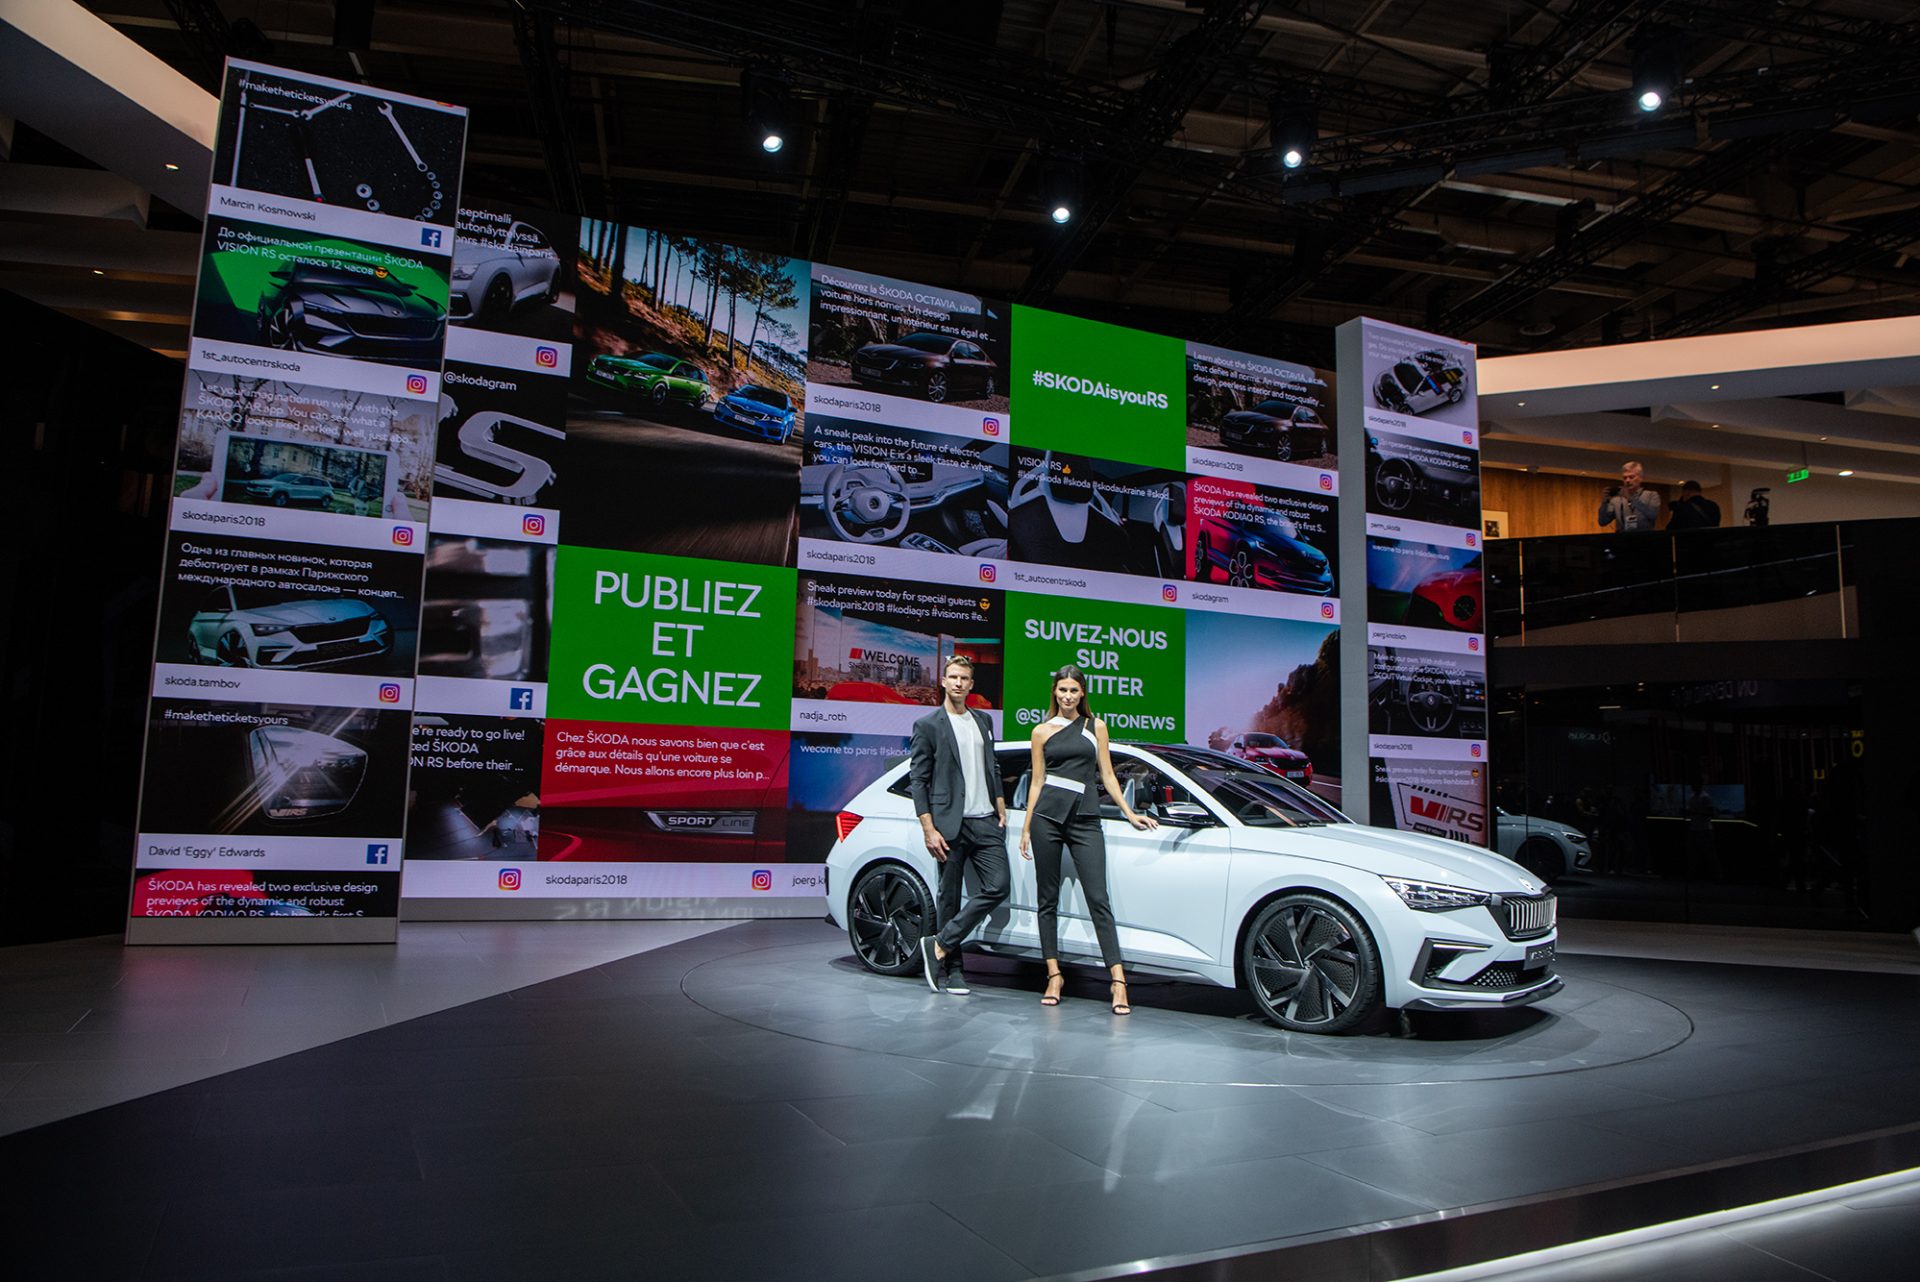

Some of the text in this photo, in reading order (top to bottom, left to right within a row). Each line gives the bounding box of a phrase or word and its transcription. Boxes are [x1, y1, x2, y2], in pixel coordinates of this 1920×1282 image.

[238, 78, 353, 111] #maketheticketsyours
[220, 196, 316, 221] Marcin Kosmowski
[218, 226, 424, 271] До официальной презентации ŠKODA
[217, 241, 374, 276] VISION RS осталось 12 часов
[821, 274, 976, 314] Découvrez ŠKODA une
[820, 288, 950, 321] voiture hors Un design
[820, 301, 978, 339] impressionnant, un intérieur sans égal
[202, 350, 301, 372] 1st_autocentrskoda
[444, 372, 517, 391] @skodagram
[1033, 370, 1168, 409] #SKODAisyouRS
[199, 394, 242, 409] ŠKODA
[814, 394, 881, 413] skodaparis2018
[197, 410, 242, 424] KAROQ
[814, 425, 980, 459] A sneak peak into the future of electric
[814, 439, 993, 473] cars, the VISION sleek taste of what
[814, 454, 906, 473] you can look forward
[1018, 456, 1061, 471] VISION RS
[1193, 457, 1243, 472] skodaparis2018
[1063, 478, 1146, 497] #skoda #skodaukraine
[1194, 481, 1328, 512] ŠKODA has revealed two exclusive design
[1194, 497, 1310, 519] previews the dynamic robust
[1194, 506, 1253, 523] ŠKODA KODIAQ
[182, 509, 266, 527] skodaparis2018
[181, 543, 373, 569] Одна из главных новинок, которая
[807, 550, 876, 565] skodaparis2018
[179, 558, 369, 582] дебютирует в рамках Парижского
[178, 573, 341, 594] международного автосалона
[1014, 572, 1087, 588] 1st_autocentrskoda
[594, 570, 762, 617] PUBLIEZ
[808, 581, 976, 608] Sneak preview today for special guests
[1192, 593, 1228, 603] skodagram
[807, 596, 969, 620] #skodaparis2018 #kodiaqrs #visionrs
[652, 622, 704, 657] ET
[1025, 619, 1168, 650] SUIVEZ-NOUS
[863, 649, 920, 667] WELCOME
[1077, 649, 1119, 670] SUR
[165, 676, 241, 689] skoda.tambov
[583, 664, 762, 708] GAGNEZ
[1050, 672, 1143, 696] ITTER
[164, 709, 289, 726] #maketheticketsyours
[800, 710, 847, 722] nadja_roth
[436, 727, 525, 741] ready to go live!
[557, 730, 764, 752] Chez ŠKODA nous savons bien que c'est
[432, 739, 479, 754] ŠKODA
[556, 748, 732, 763] grâce aux détails qu'une voiture se
[800, 744, 878, 758] wecome to paris
[427, 757, 443, 768] RS
[446, 759, 483, 770] before
[486, 760, 512, 770] their
[555, 764, 753, 781] démarque. Nous allons encore plus loin
[668, 816, 750, 827] SPORT LINE
[148, 845, 266, 857] David Edwards
[148, 877, 378, 893] ŠKODA has revealed two exclusive design
[546, 874, 628, 888] skodaparis2018
[146, 896, 344, 908] previews of the dynamic and robust
